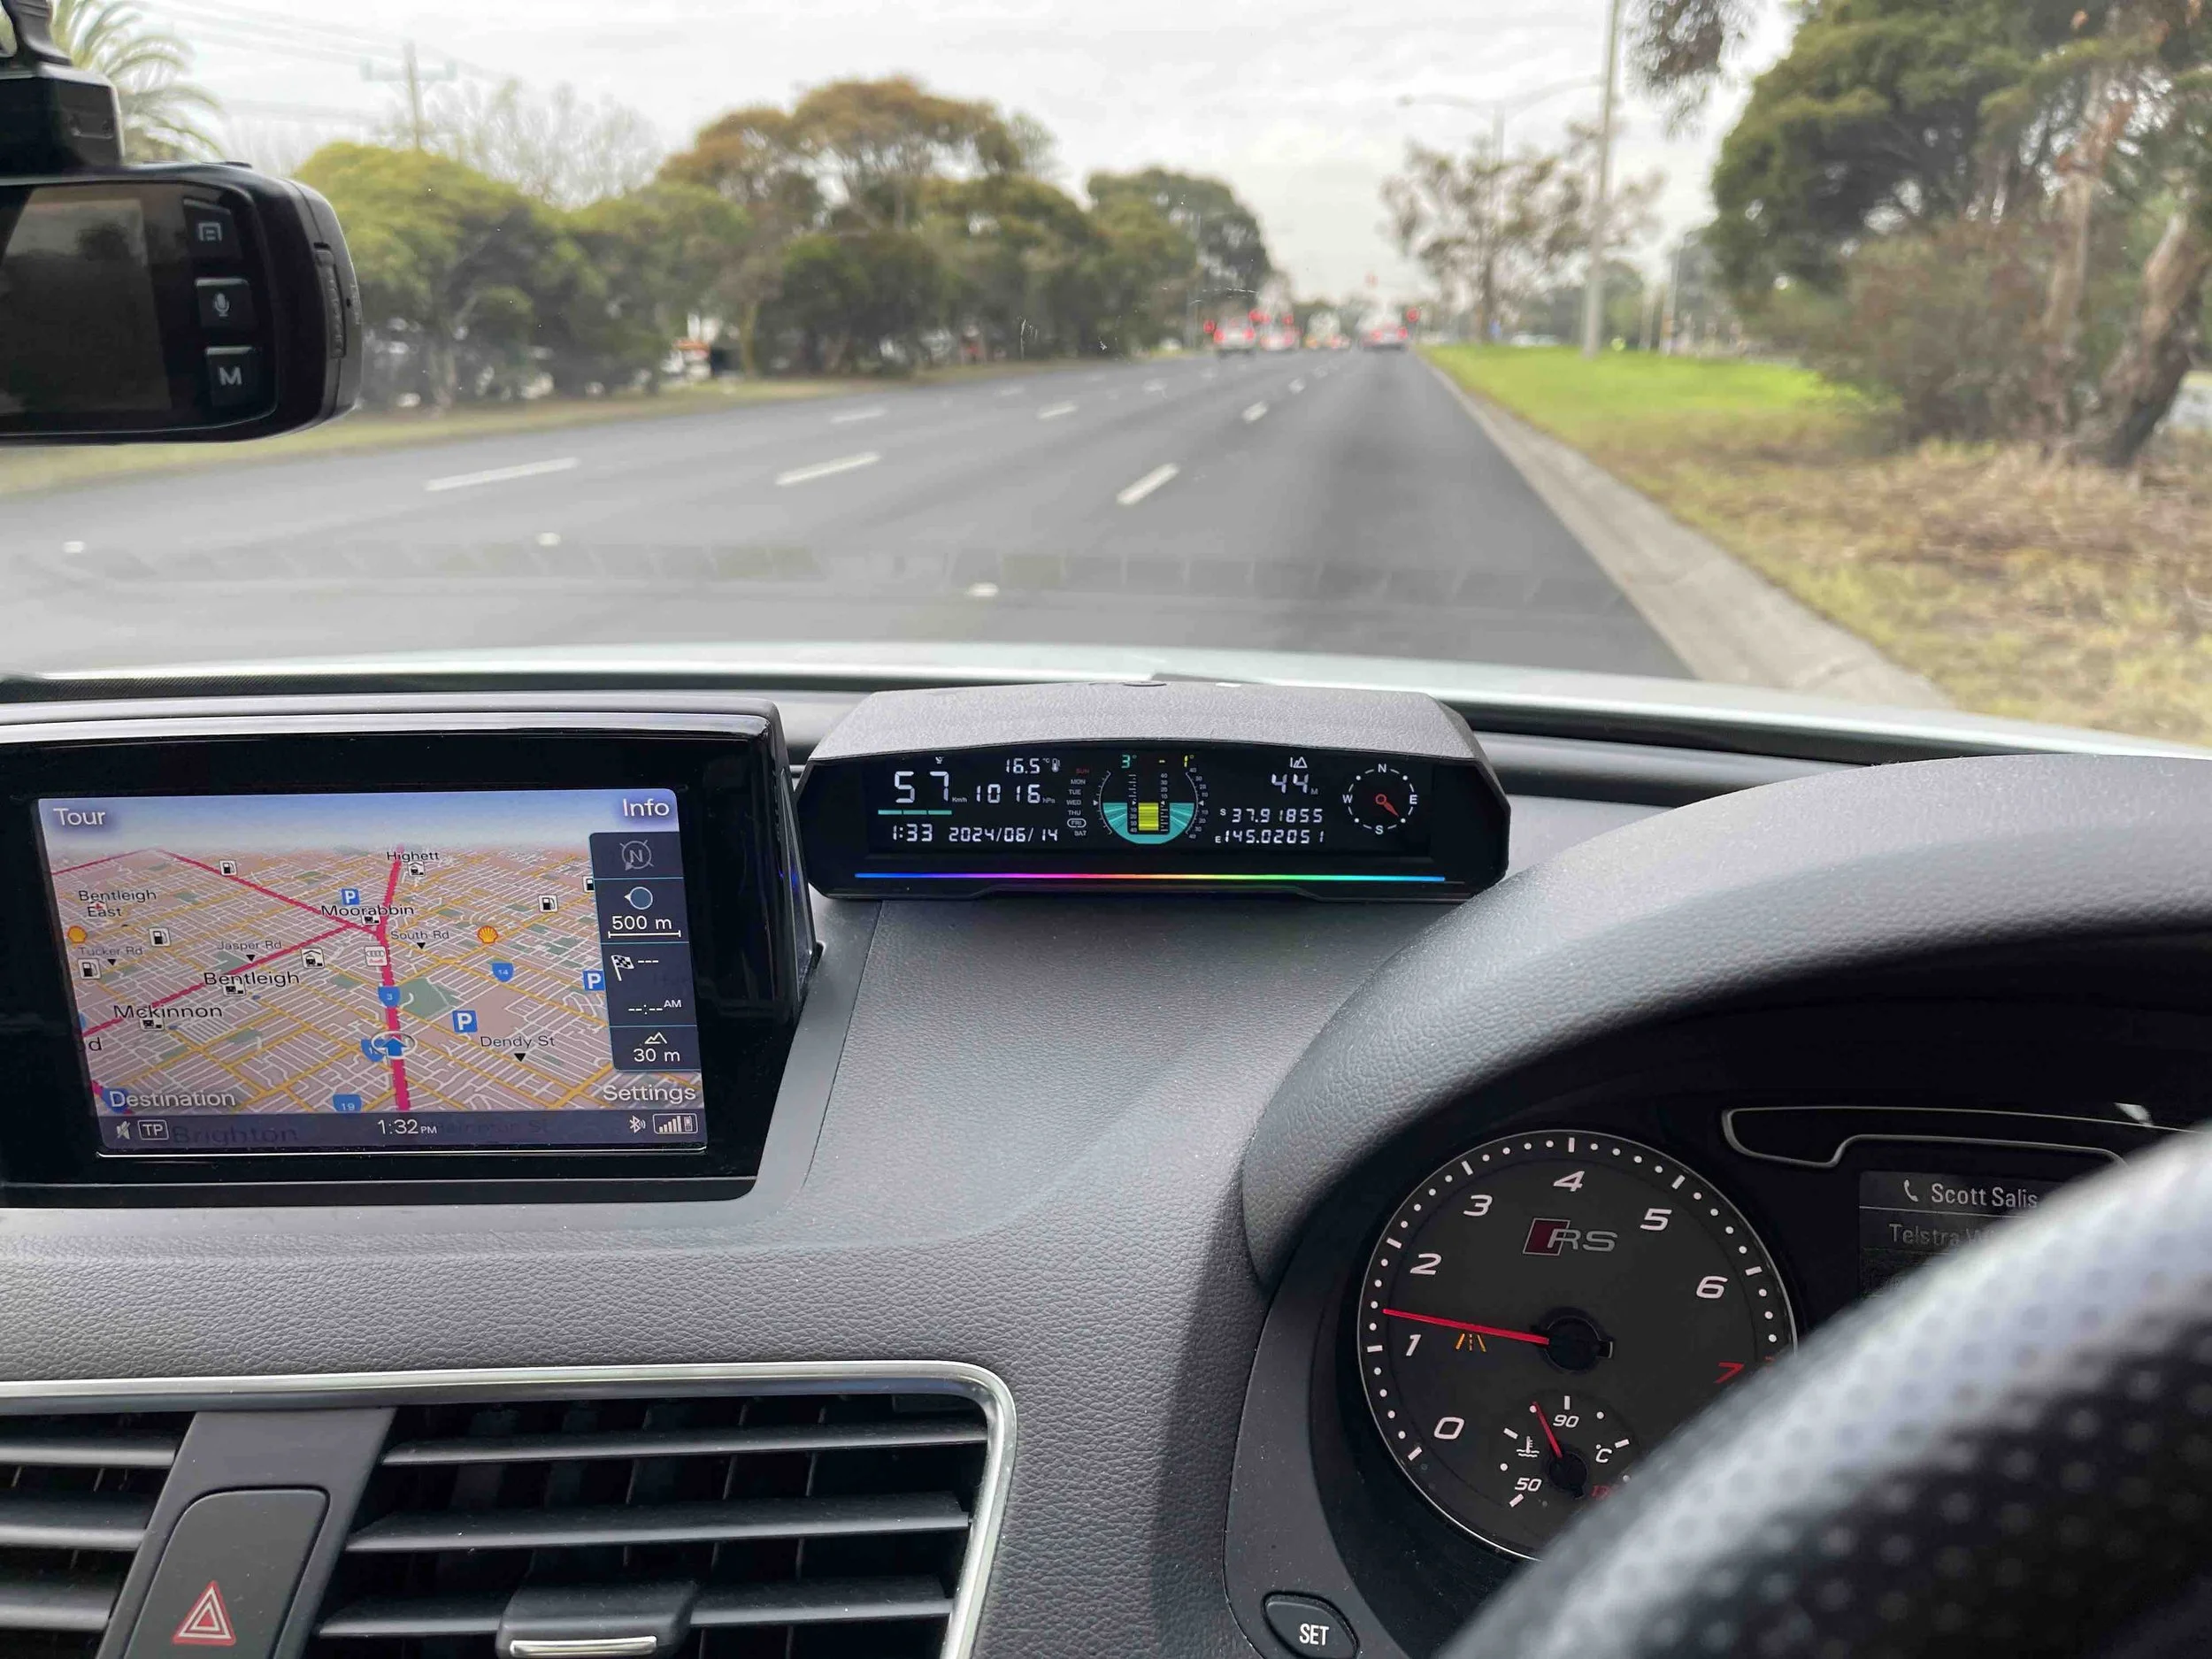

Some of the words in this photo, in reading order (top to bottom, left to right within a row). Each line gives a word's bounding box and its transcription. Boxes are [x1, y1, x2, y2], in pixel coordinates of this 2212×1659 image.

[219, 367, 242, 385] M
[1005, 758, 1041, 774] 16.5
[1378, 764, 1387, 773] N
[894, 771, 949, 803] 57
[1271, 773, 1310, 794] 44
[623, 798, 670, 817] Info
[1342, 795, 1353, 804] W
[1409, 795, 1417, 804] E
[53, 807, 106, 826] Tour
[1232, 808, 1323, 823] 37.91855
[893, 824, 933, 841] 1:33
[1375, 825, 1384, 834] S
[387, 850, 440, 863] Highett
[79, 889, 157, 902] Bentleigh
[88, 907, 122, 917] East
[321, 904, 414, 917] Moorabbin
[611, 916, 647, 930] 500
[656, 918, 672, 929] m
[391, 931, 428, 941] South
[433, 930, 449, 940] Rd
[79, 947, 120, 956] Tucker
[126, 947, 143, 956] Rd
[218, 941, 259, 951] Jasper
[265, 941, 282, 949] Rd
[204, 972, 300, 987] Bentleigh
[480, 1036, 533, 1048] Dendy
[538, 1035, 556, 1047] St
[634, 1048, 657, 1062] 30
[664, 1050, 680, 1062] m
[109, 1091, 236, 1108] Destination
[603, 1086, 696, 1102] Settings
[142, 1124, 164, 1137] TP
[1553, 1171, 1585, 1191] 4
[1931, 1183, 1987, 1206] Scott
[1463, 1194, 1493, 1217] 3
[1640, 1209, 1671, 1231] 5
[1547, 1228, 1618, 1252] RS
[1889, 1223, 1960, 1247] Telstra
[1410, 1253, 1441, 1275] 2
[1696, 1276, 1728, 1299] 6
[1405, 1334, 1421, 1356] 1
[1714, 1363, 1745, 1383] 7
[1433, 1417, 1464, 1440] 0
[1553, 1414, 1579, 1428] 90
[1514, 1478, 1541, 1492] 50
[1299, 1623, 1329, 1646] SET
